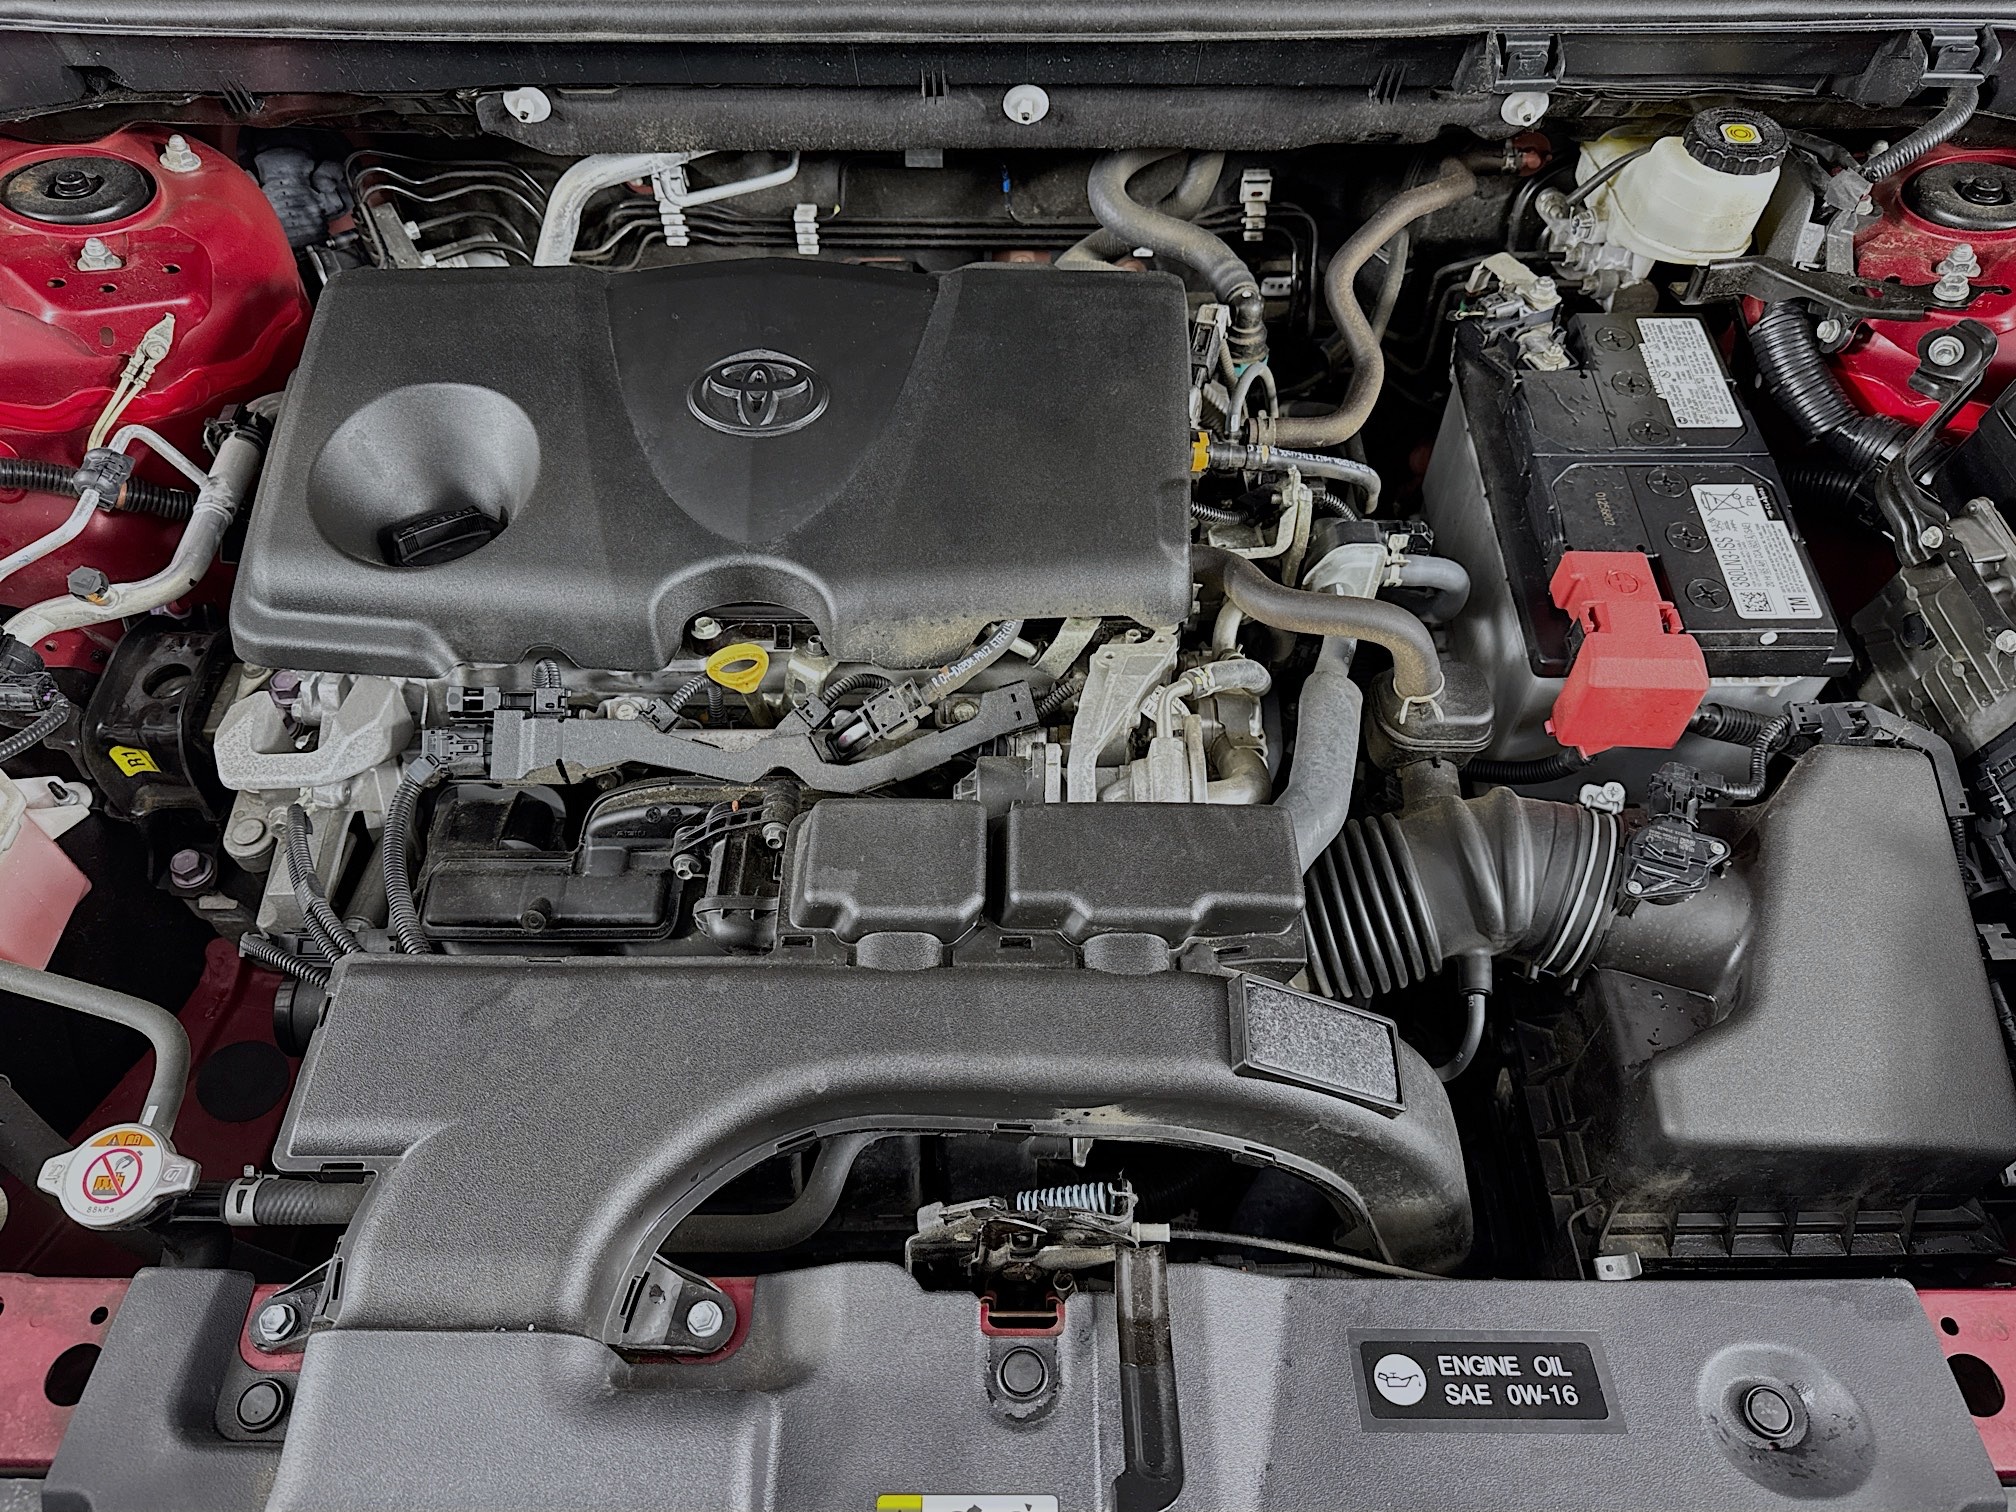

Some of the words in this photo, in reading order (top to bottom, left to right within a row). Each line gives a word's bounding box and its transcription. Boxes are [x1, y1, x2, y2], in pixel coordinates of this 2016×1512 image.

[1746, 495, 1757, 506] Pb
[1714, 536, 1751, 588] 380LN3-ISS
[1787, 597, 1811, 613] TM
[86, 1205, 115, 1213] 88kPa
[1437, 1355, 1521, 1377] ENGINE
[1533, 1355, 1573, 1377] OIL
[1444, 1383, 1493, 1406] SAE
[1506, 1384, 1579, 1406] 0W-16
